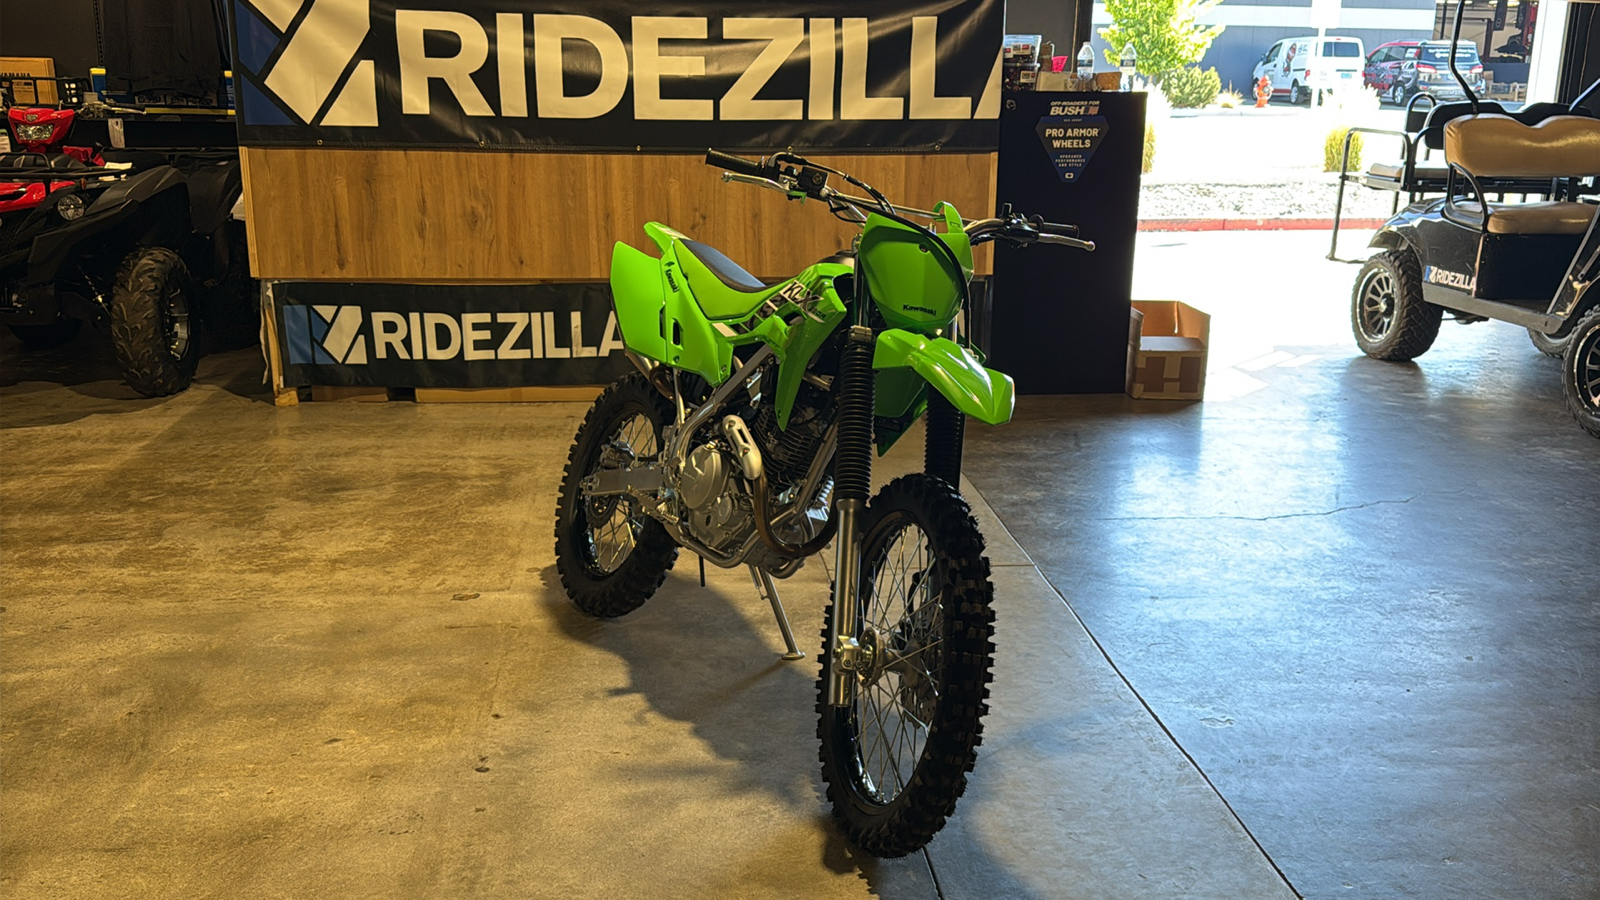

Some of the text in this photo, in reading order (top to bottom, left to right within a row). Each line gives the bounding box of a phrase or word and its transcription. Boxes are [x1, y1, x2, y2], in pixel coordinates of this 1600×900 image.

[1049, 106, 1085, 116] BUSH
[1045, 128, 1099, 138] PRO ARMOR
[1052, 138, 1091, 149] WHEELS
[664, 268, 680, 293] Kawasaki
[1436, 268, 1475, 288] RIDEZILLA
[902, 304, 937, 316] Kawasaki
[371, 310, 625, 361] RIDEZILLA
